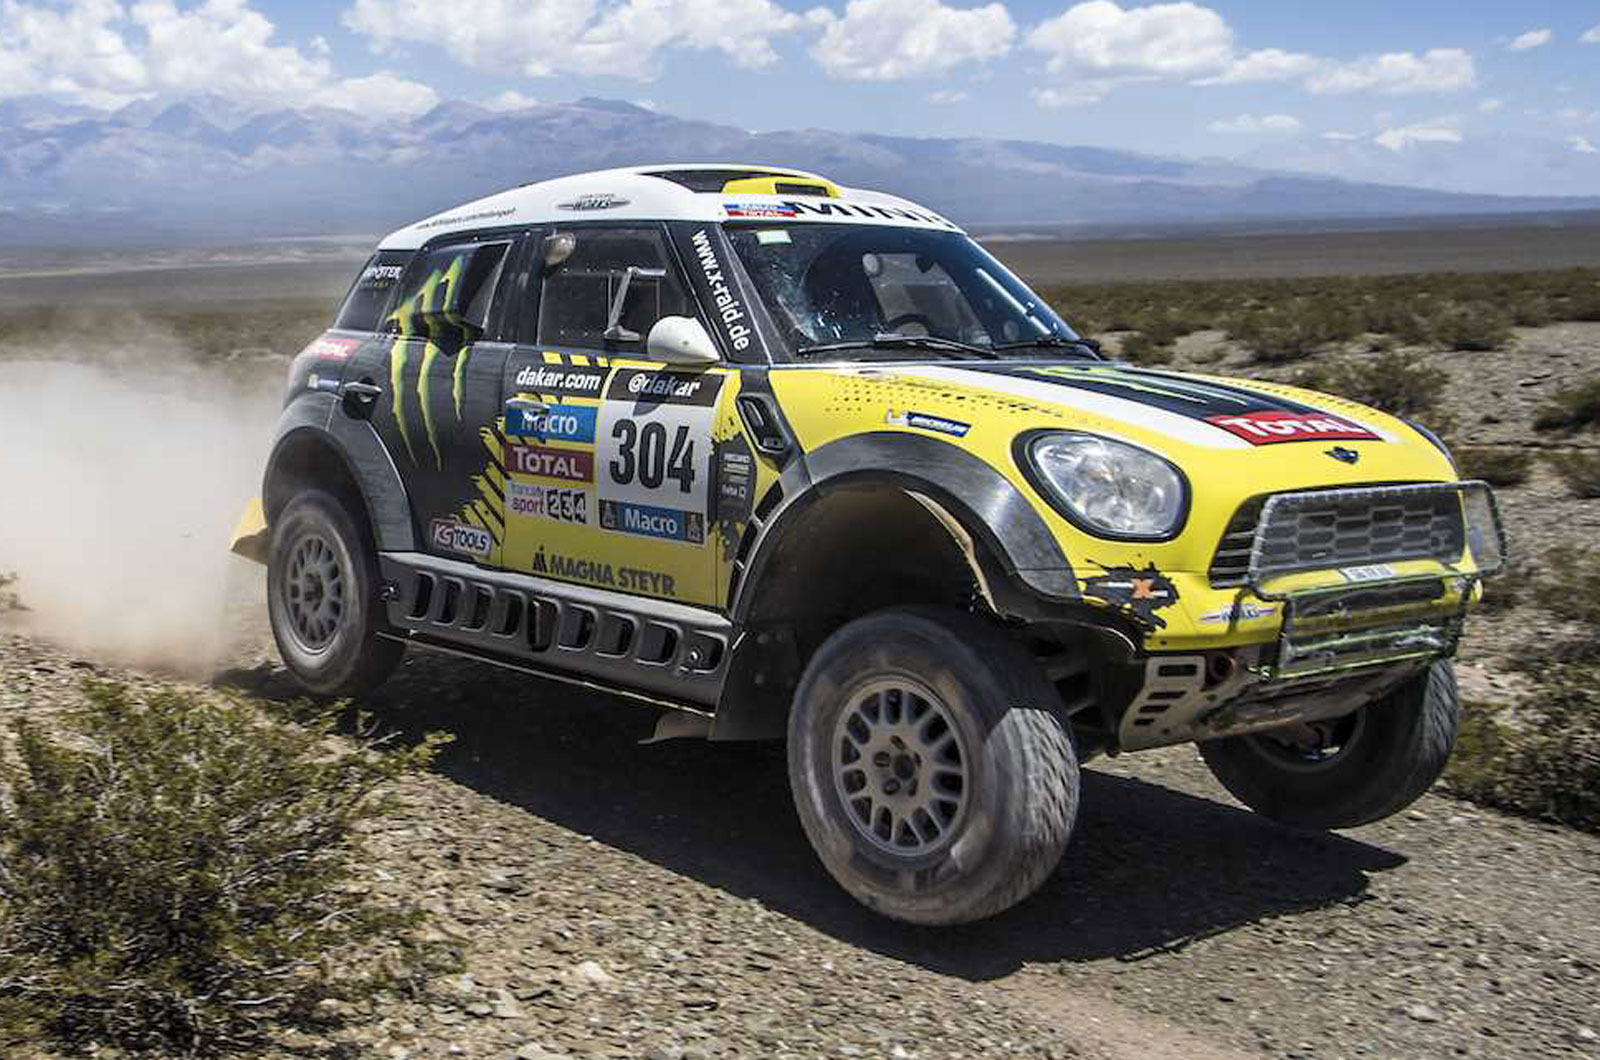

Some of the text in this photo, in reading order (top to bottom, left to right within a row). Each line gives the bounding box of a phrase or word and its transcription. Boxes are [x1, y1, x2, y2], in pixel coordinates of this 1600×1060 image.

[691, 229, 750, 351] www.x-raid.de
[516, 366, 601, 390] dakar.com
[628, 373, 701, 396] @dakar
[609, 418, 695, 493] 304
[512, 497, 545, 515] sport
[625, 508, 679, 535] Macro
[551, 554, 676, 596] MAGNA STEYR
